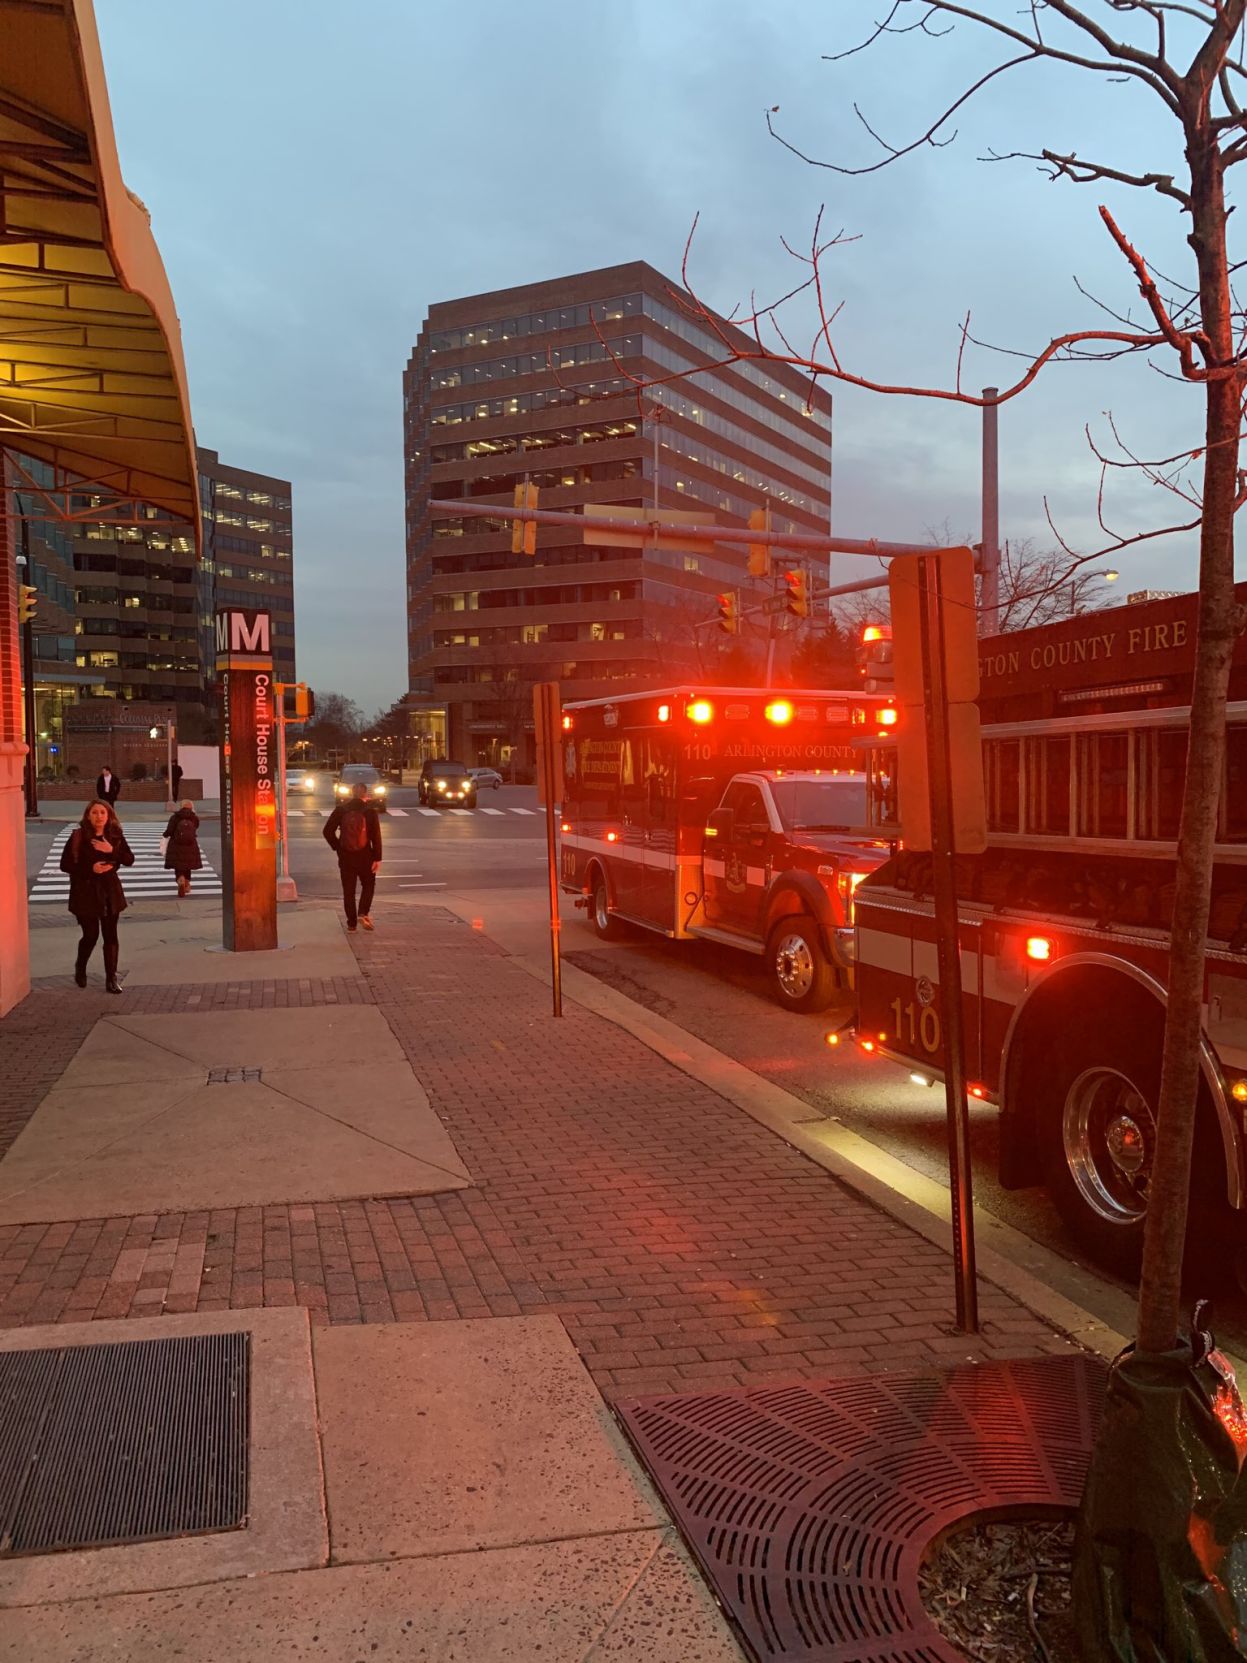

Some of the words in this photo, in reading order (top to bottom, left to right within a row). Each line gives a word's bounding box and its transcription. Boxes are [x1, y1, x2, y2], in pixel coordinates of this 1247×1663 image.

[216, 612, 228, 651] M
[231, 612, 270, 652] M
[1030, 632, 1115, 669] COUNTY
[1127, 620, 1188, 655] FIRE
[255, 673, 269, 720] Court
[256, 723, 270, 775] House
[684, 743, 711, 760] 110
[723, 744, 802, 759] ARLINGTON
[805, 745, 858, 760] COUNTY
[257, 779, 271, 835] Staon
[890, 996, 941, 1053] 110
